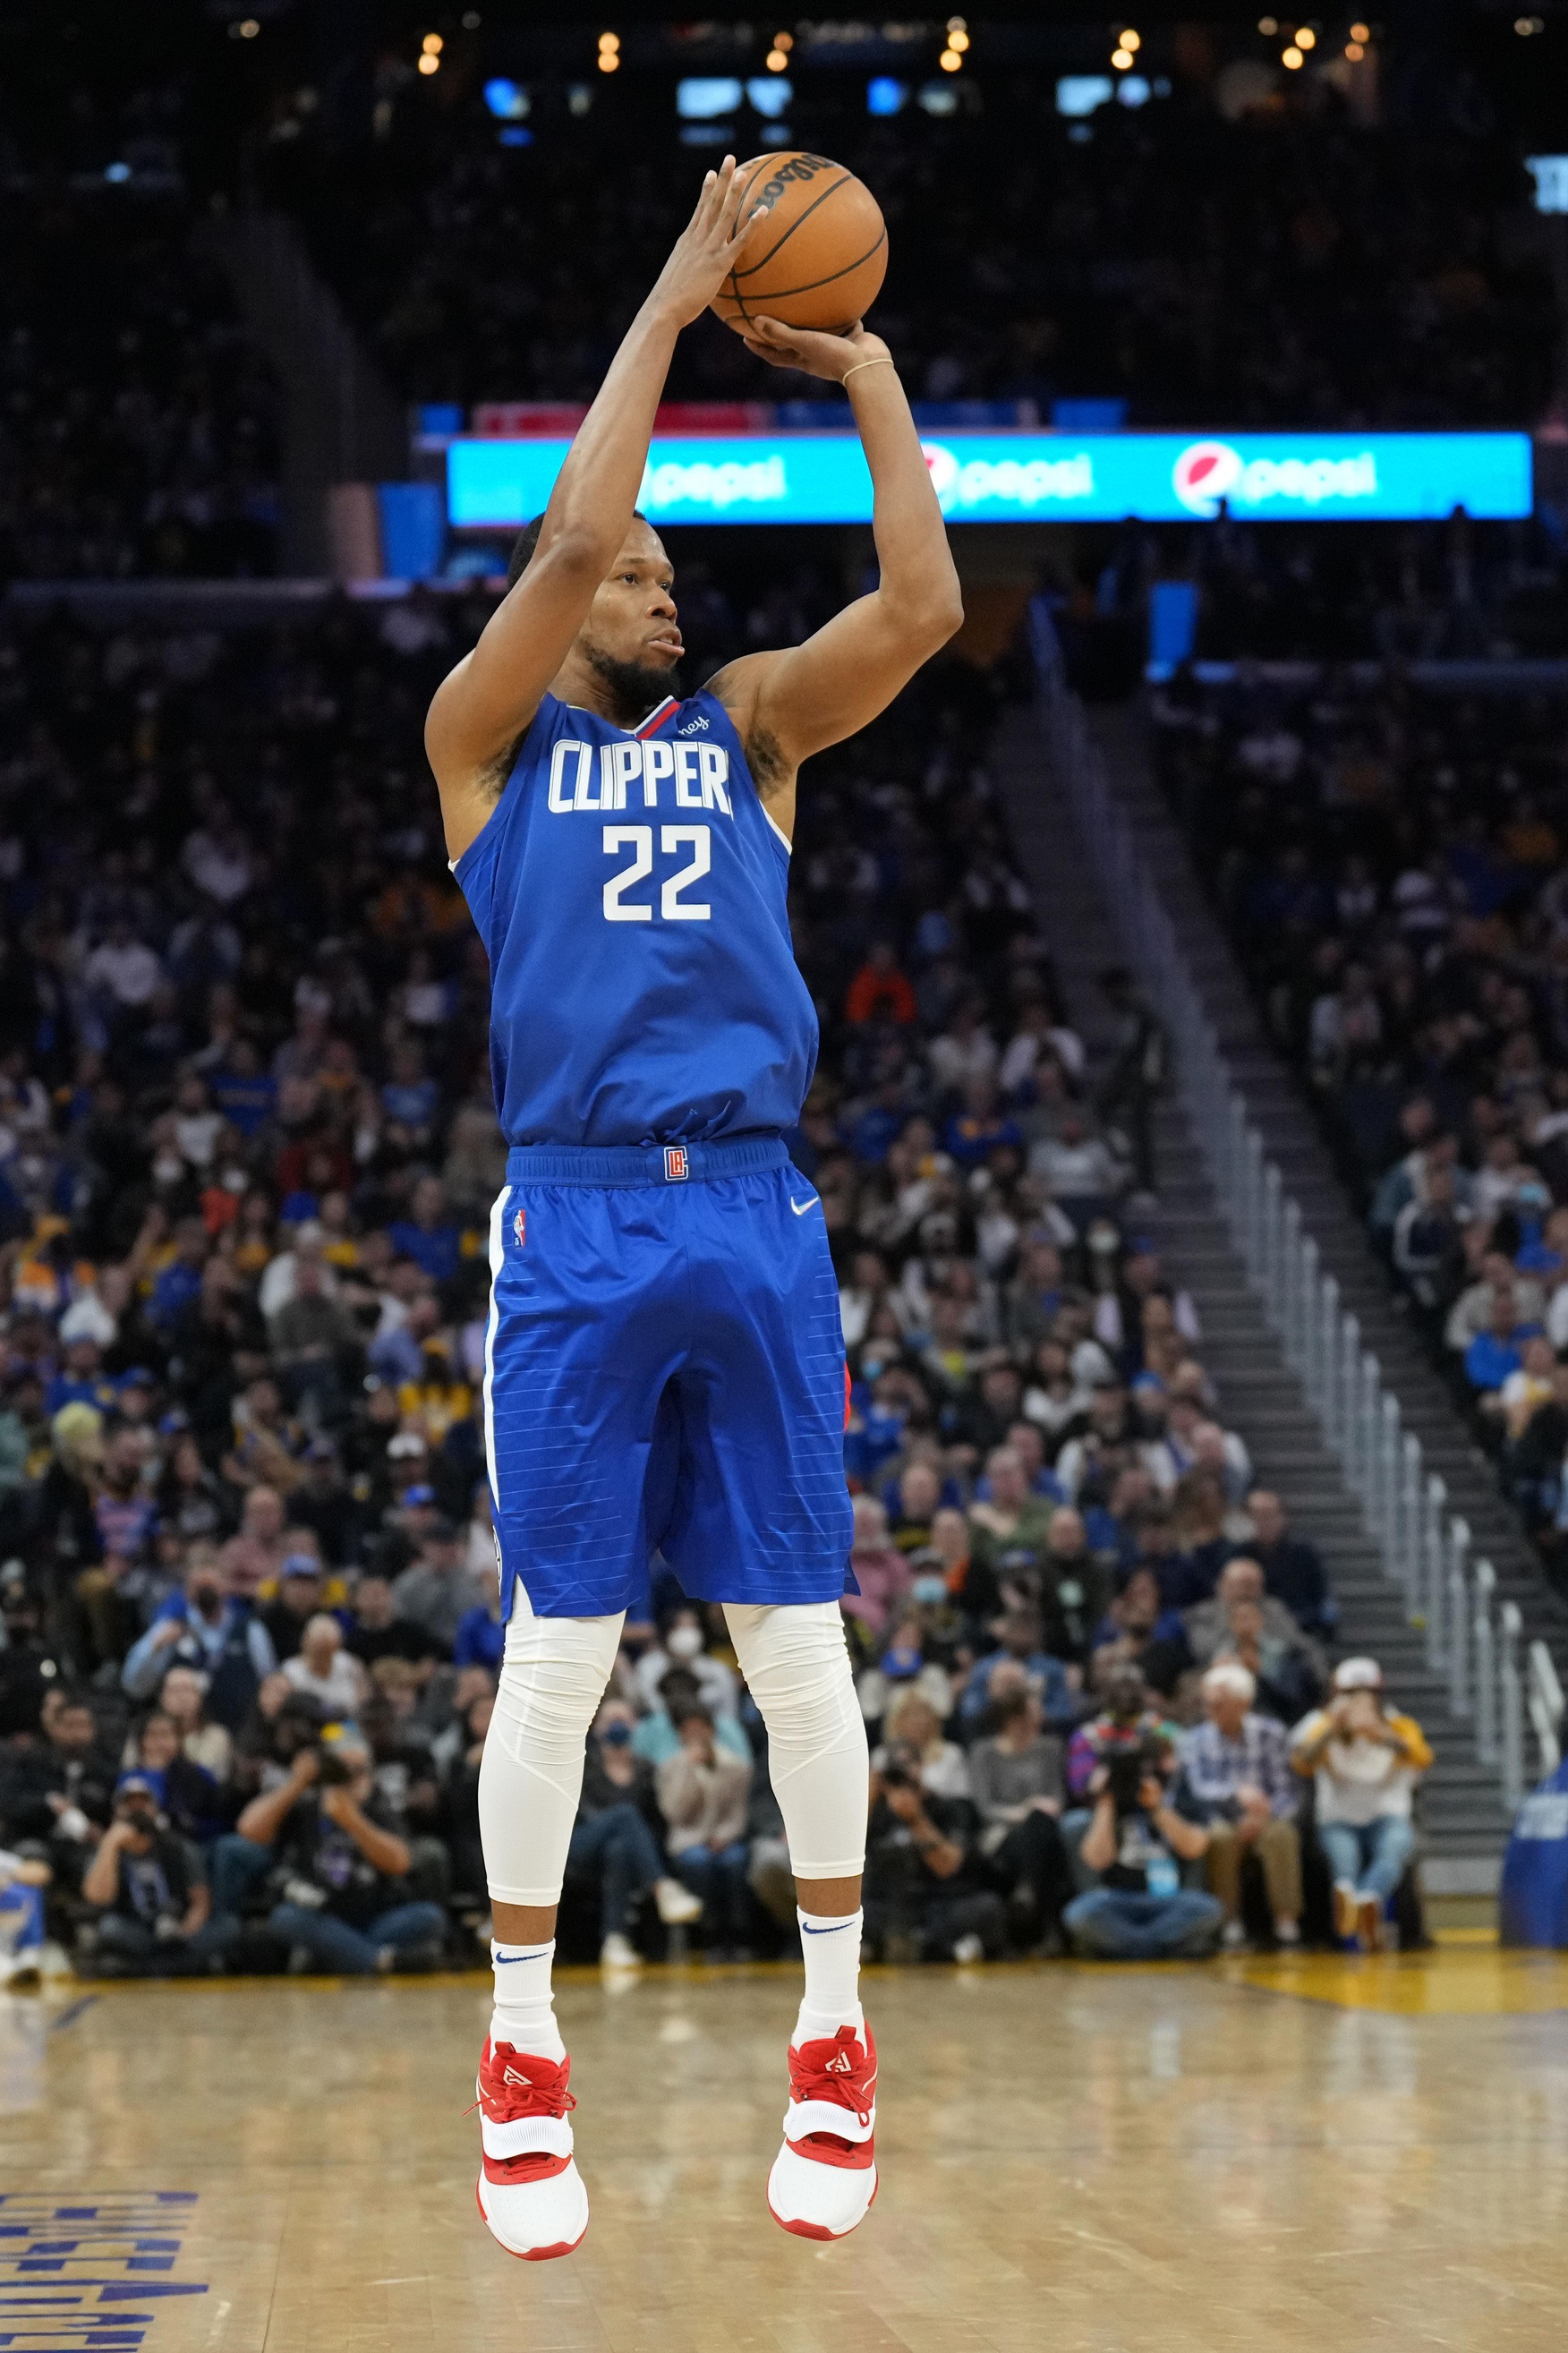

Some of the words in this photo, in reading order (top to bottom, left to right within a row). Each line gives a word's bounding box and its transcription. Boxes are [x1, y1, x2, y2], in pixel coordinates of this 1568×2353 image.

[959, 452, 1095, 507] pepsi
[1247, 451, 1378, 506] pepsi
[548, 739, 734, 820] CLIPPER
[602, 824, 712, 922] 22
